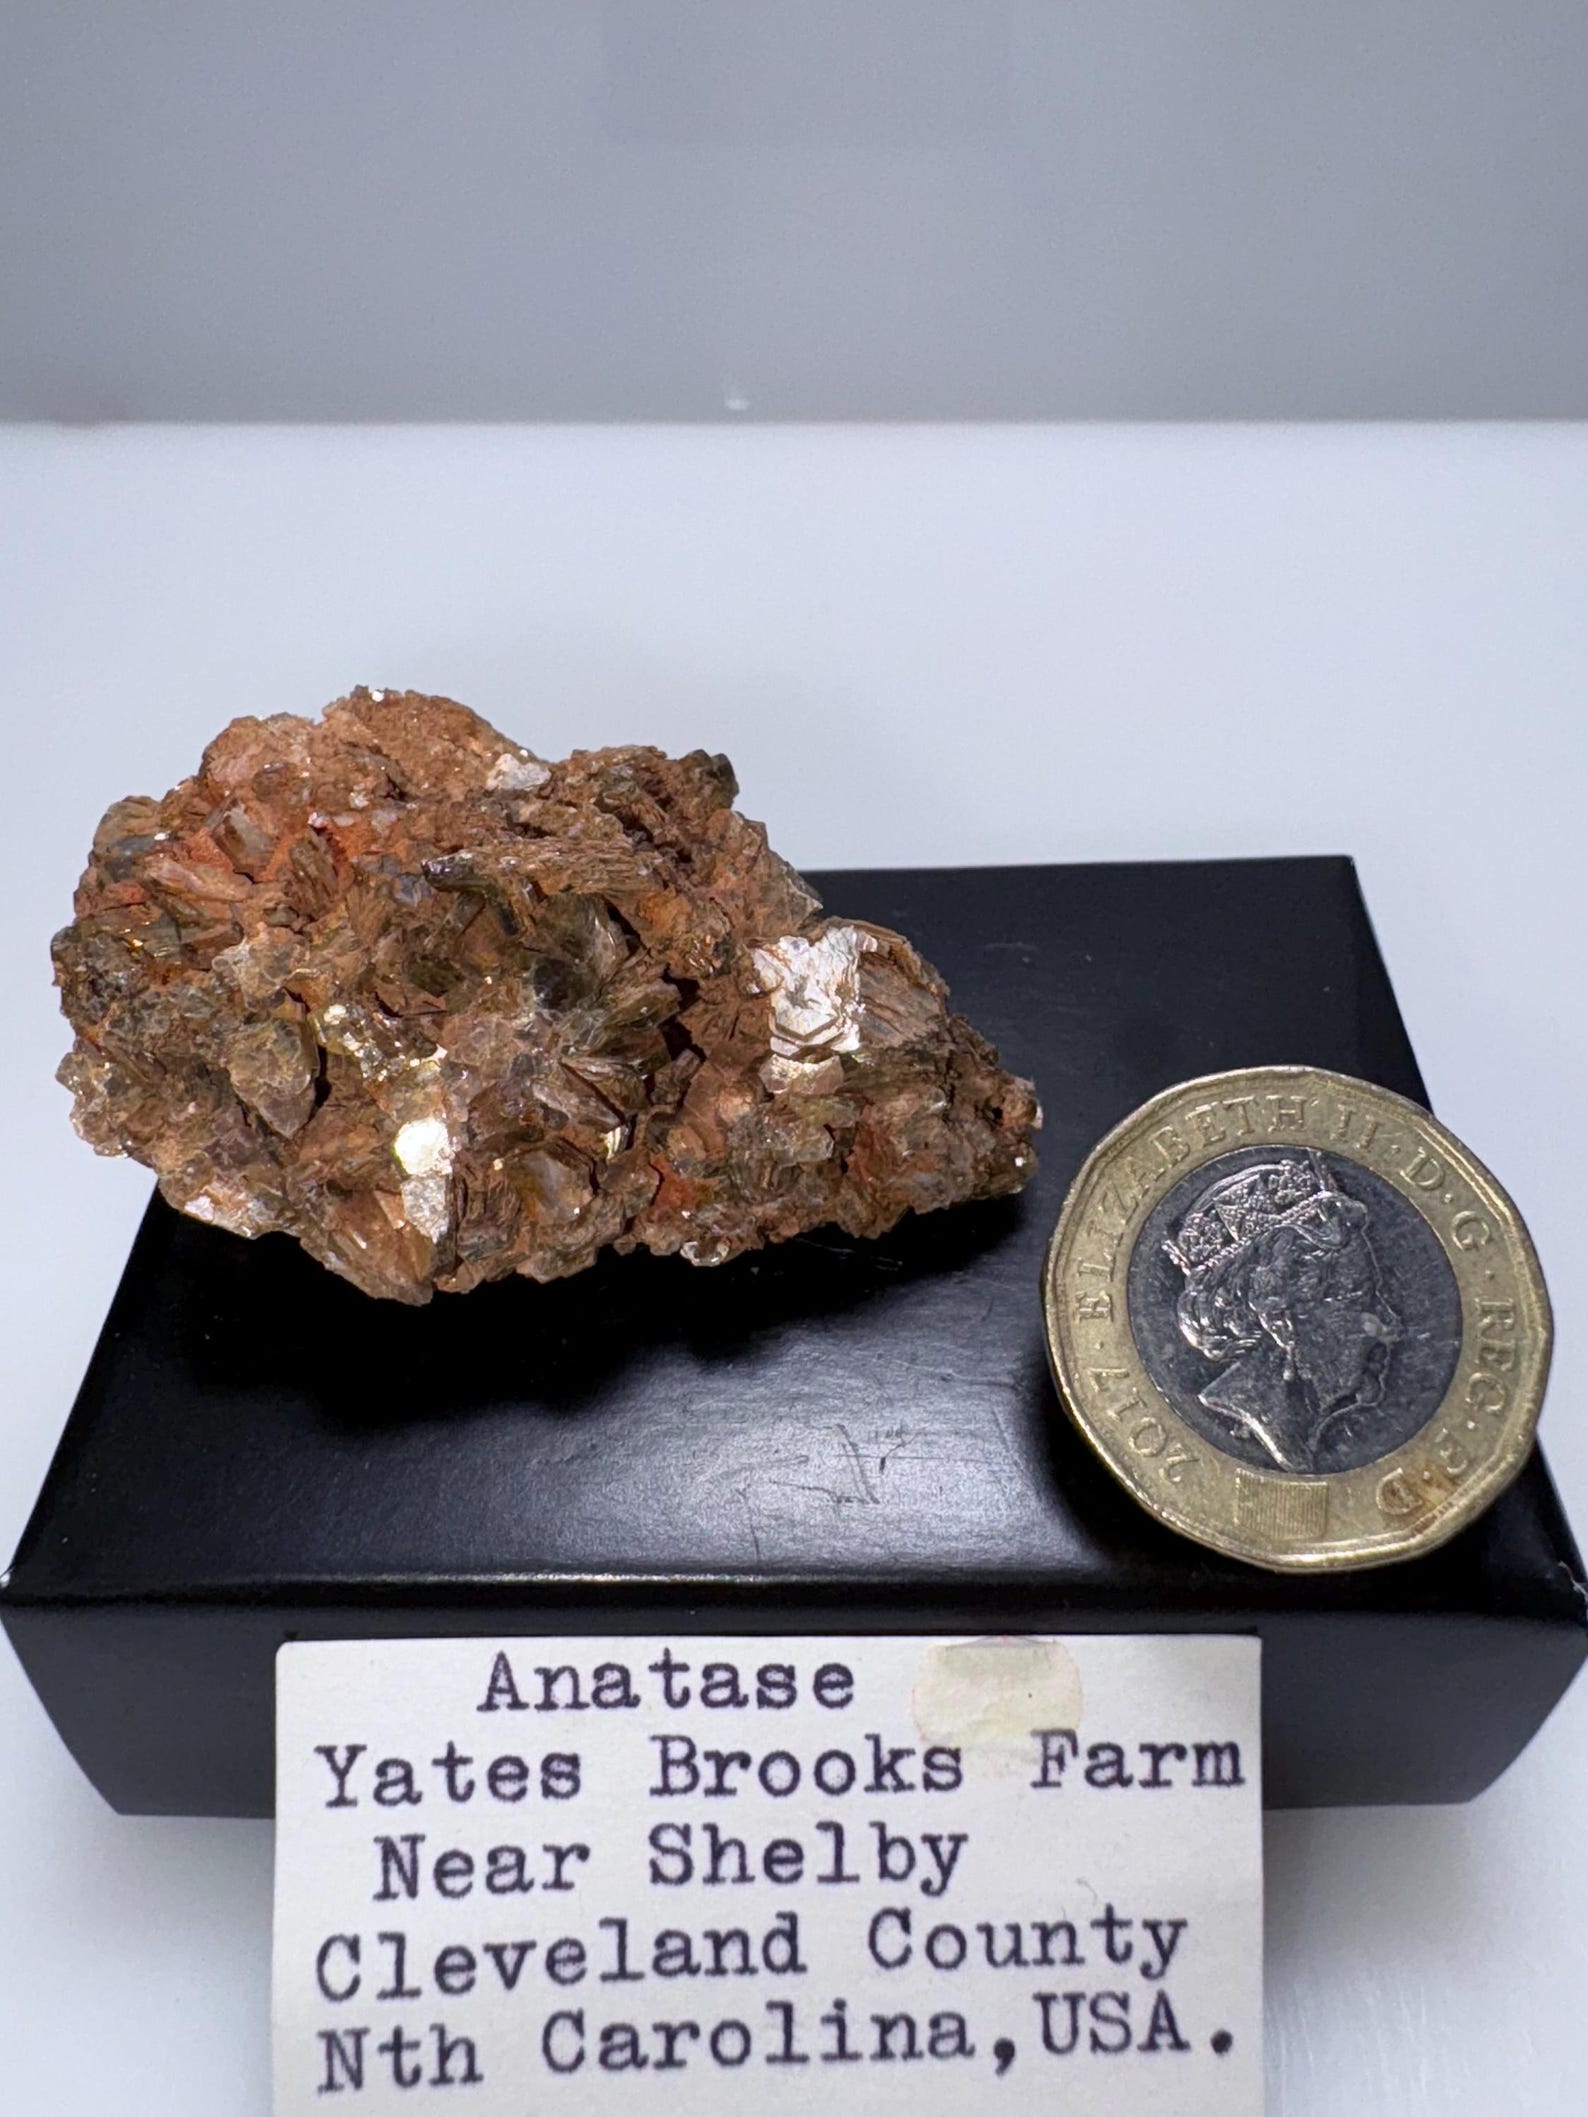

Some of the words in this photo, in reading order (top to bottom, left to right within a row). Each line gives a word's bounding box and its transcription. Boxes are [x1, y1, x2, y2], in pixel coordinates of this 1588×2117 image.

[1329, 1104, 1382, 1151] II
[1073, 1095, 1308, 1325] ELIZABETH
[1093, 1364, 1201, 1484] 2017
[476, 1648, 854, 1711] Anatase
[314, 1742, 581, 1808] Yates
[649, 1734, 963, 1797] Brooks
[1030, 1729, 1246, 1789] Farm
[373, 1834, 590, 1901] Near
[648, 1821, 968, 1897] Shelby
[316, 1913, 808, 2002] Cleveland
[868, 1904, 1188, 1981] County
[317, 2024, 484, 2093] Nth
